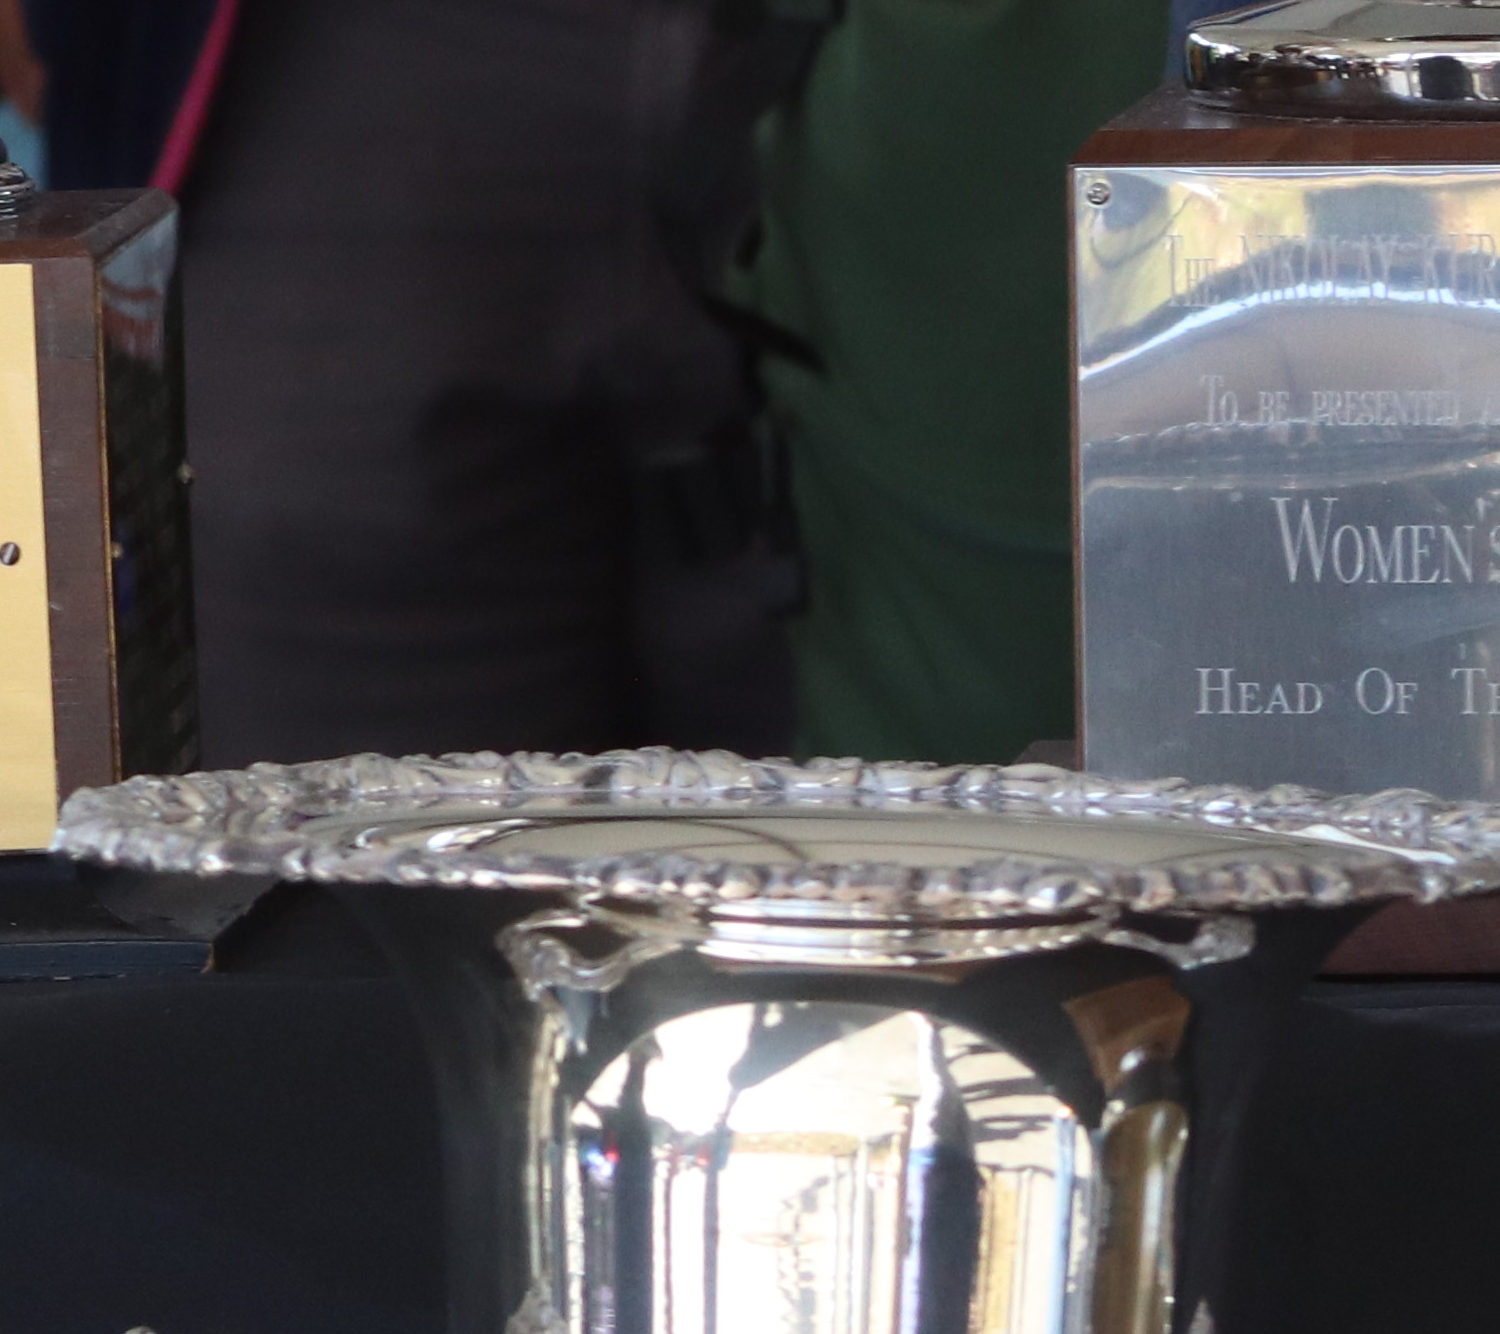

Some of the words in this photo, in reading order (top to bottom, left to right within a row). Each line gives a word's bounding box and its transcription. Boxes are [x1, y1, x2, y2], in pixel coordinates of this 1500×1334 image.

[1259, 390, 1290, 426] BE
[1196, 667, 1323, 715] HEAD
[1355, 667, 1418, 715] OF
